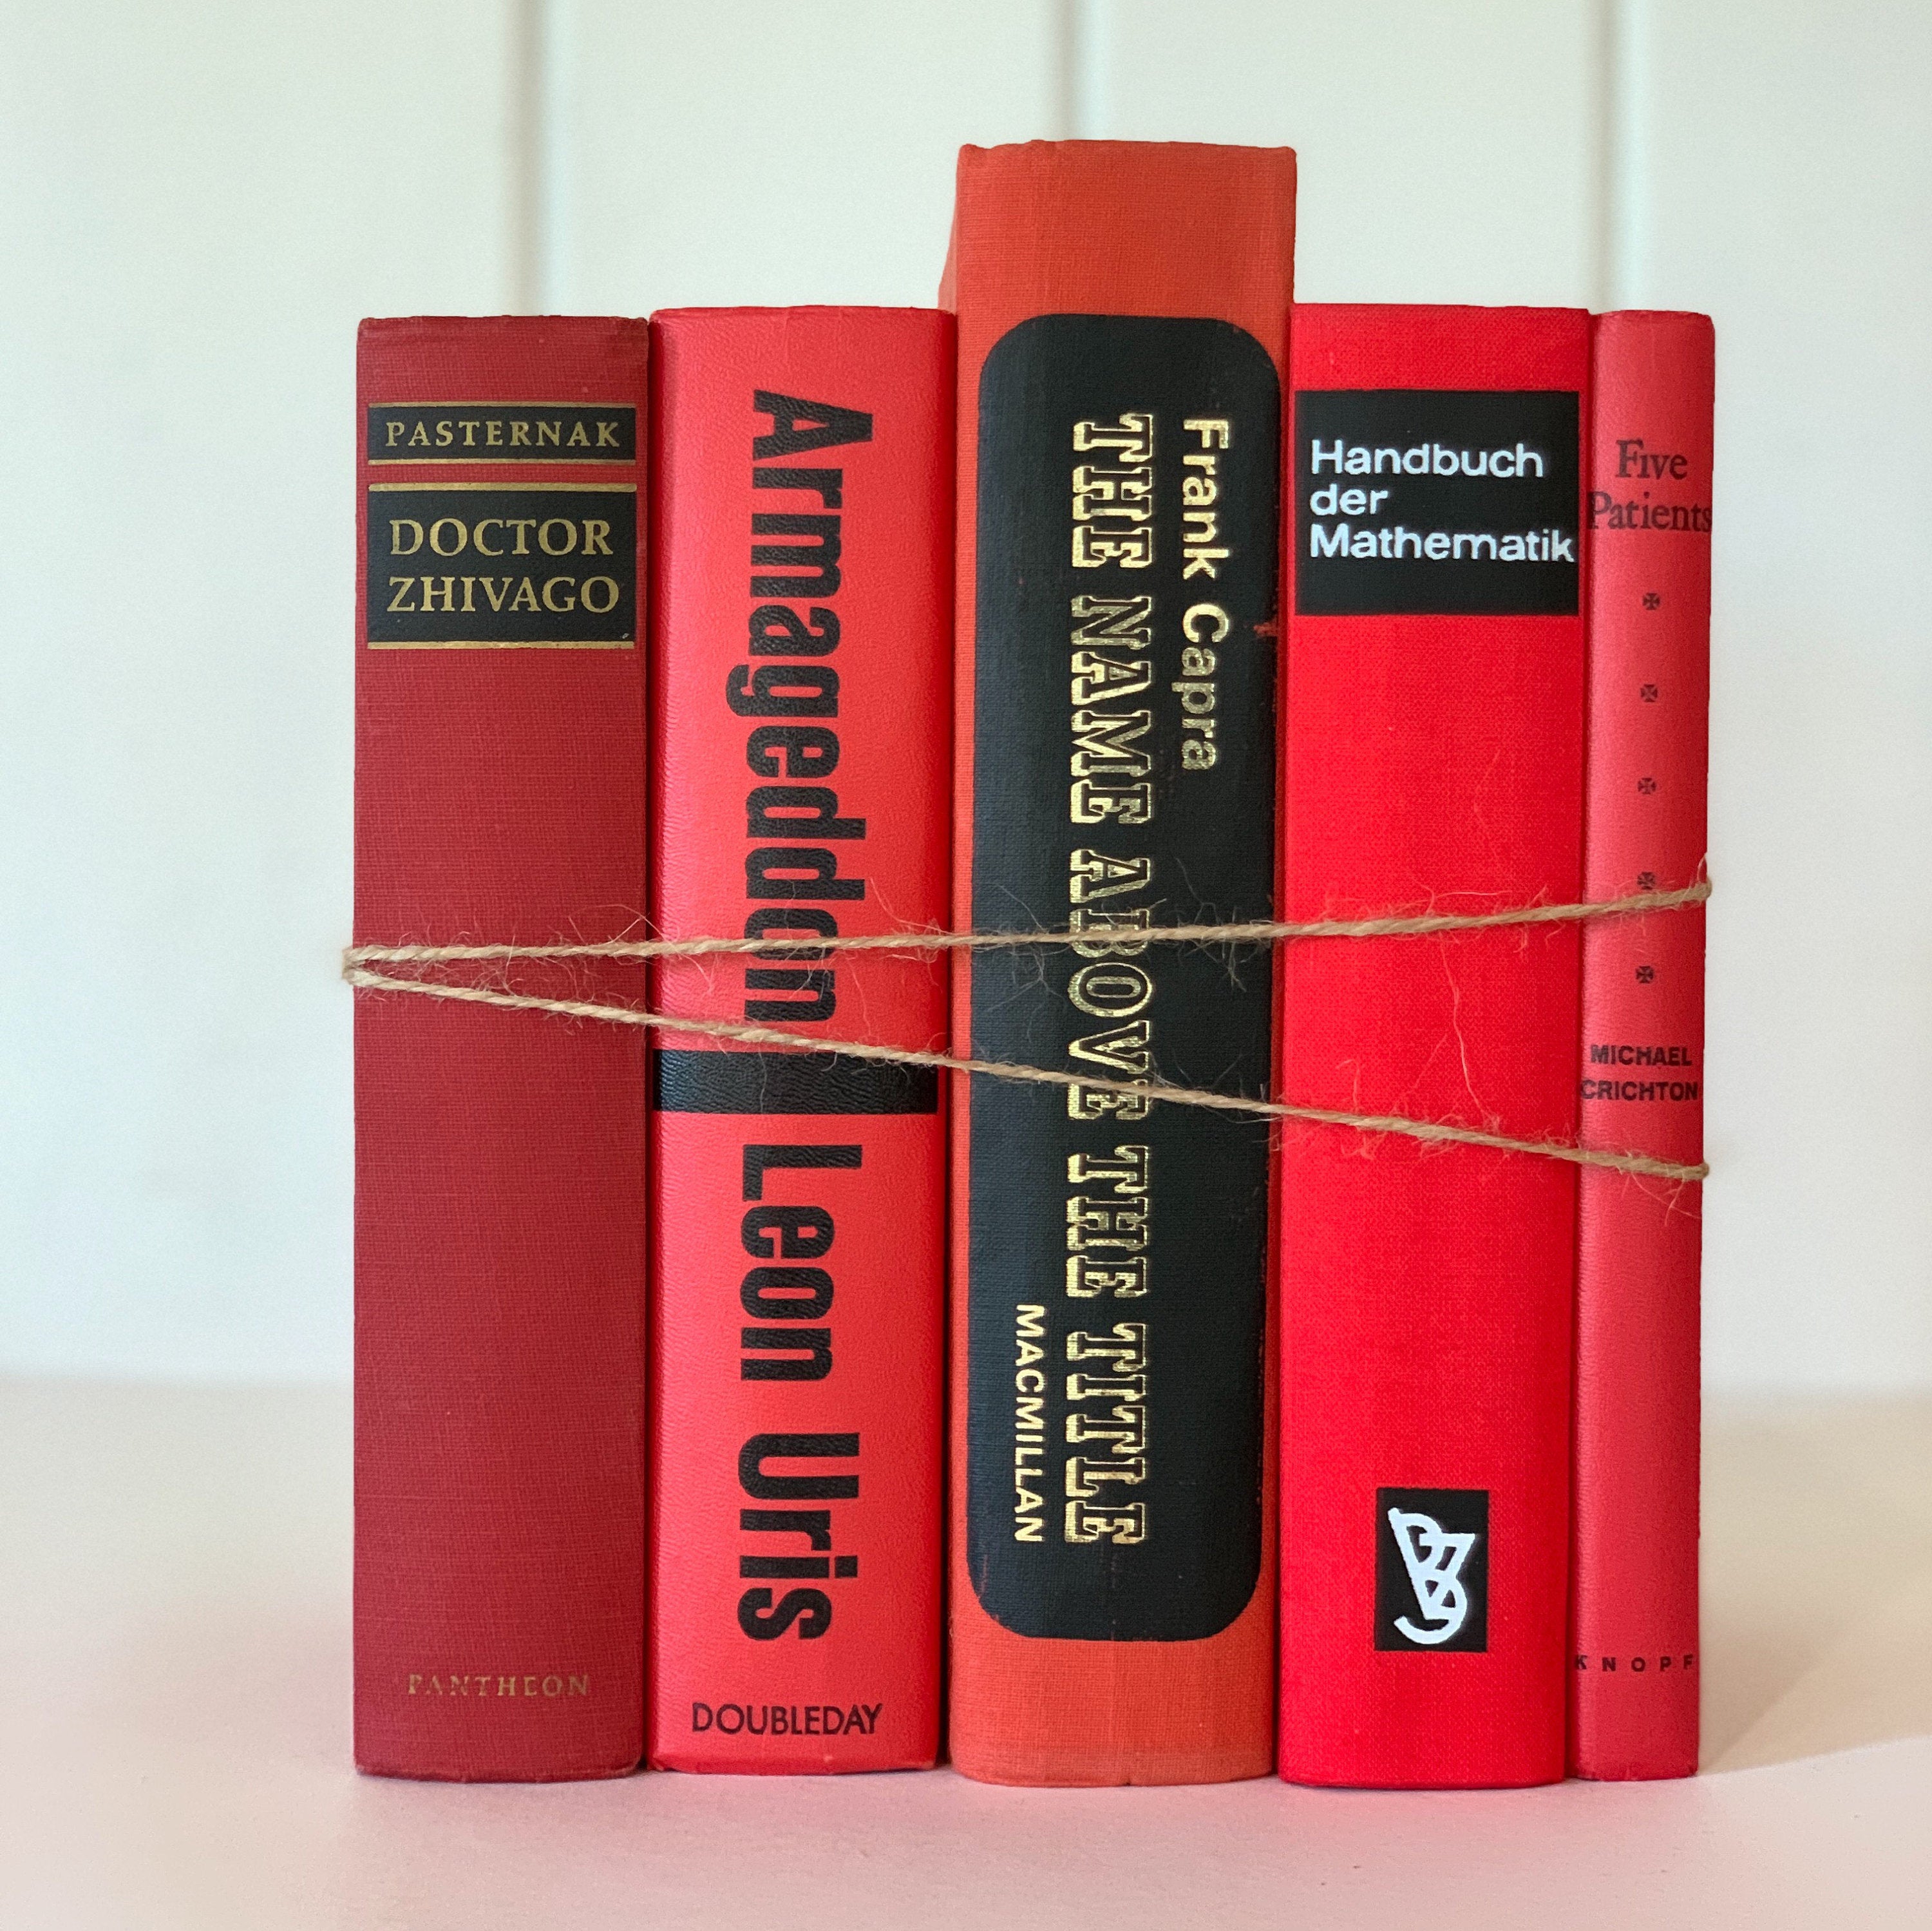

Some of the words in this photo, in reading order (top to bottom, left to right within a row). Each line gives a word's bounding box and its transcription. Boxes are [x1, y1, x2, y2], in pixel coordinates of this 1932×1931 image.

[386, 421, 620, 447] PASTERNAK
[1310, 439, 1544, 478] Handbuch
[1615, 439, 1689, 480] Five
[1071, 412, 1153, 568] THE
[1182, 419, 1230, 580] Frank
[1309, 483, 1389, 516] der
[1587, 490, 1713, 533] Patients
[389, 518, 614, 556] DOCTOR
[1309, 523, 1577, 562] Mathematik
[386, 576, 620, 613] ZHIVAGO
[725, 388, 873, 1022] Armageddon
[1171, 602, 1230, 771] Capra
[1070, 594, 1152, 824] NAME
[1066, 848, 1153, 1120] ABOVE
[1591, 1044, 1693, 1067] MICHAEL
[1582, 1079, 1699, 1101] CRICHTON
[1065, 1144, 1150, 1298] THE
[739, 1144, 862, 1382] Leon
[1014, 1303, 1046, 1542] MACMILLAN
[1065, 1322, 1147, 1544] TITLE
[737, 1432, 860, 1641] Uris
[1575, 1653, 1694, 1673] KNOPF
[407, 1674, 589, 1697] PANTHEON
[691, 1702, 883, 1736] DOUBLEDAY
